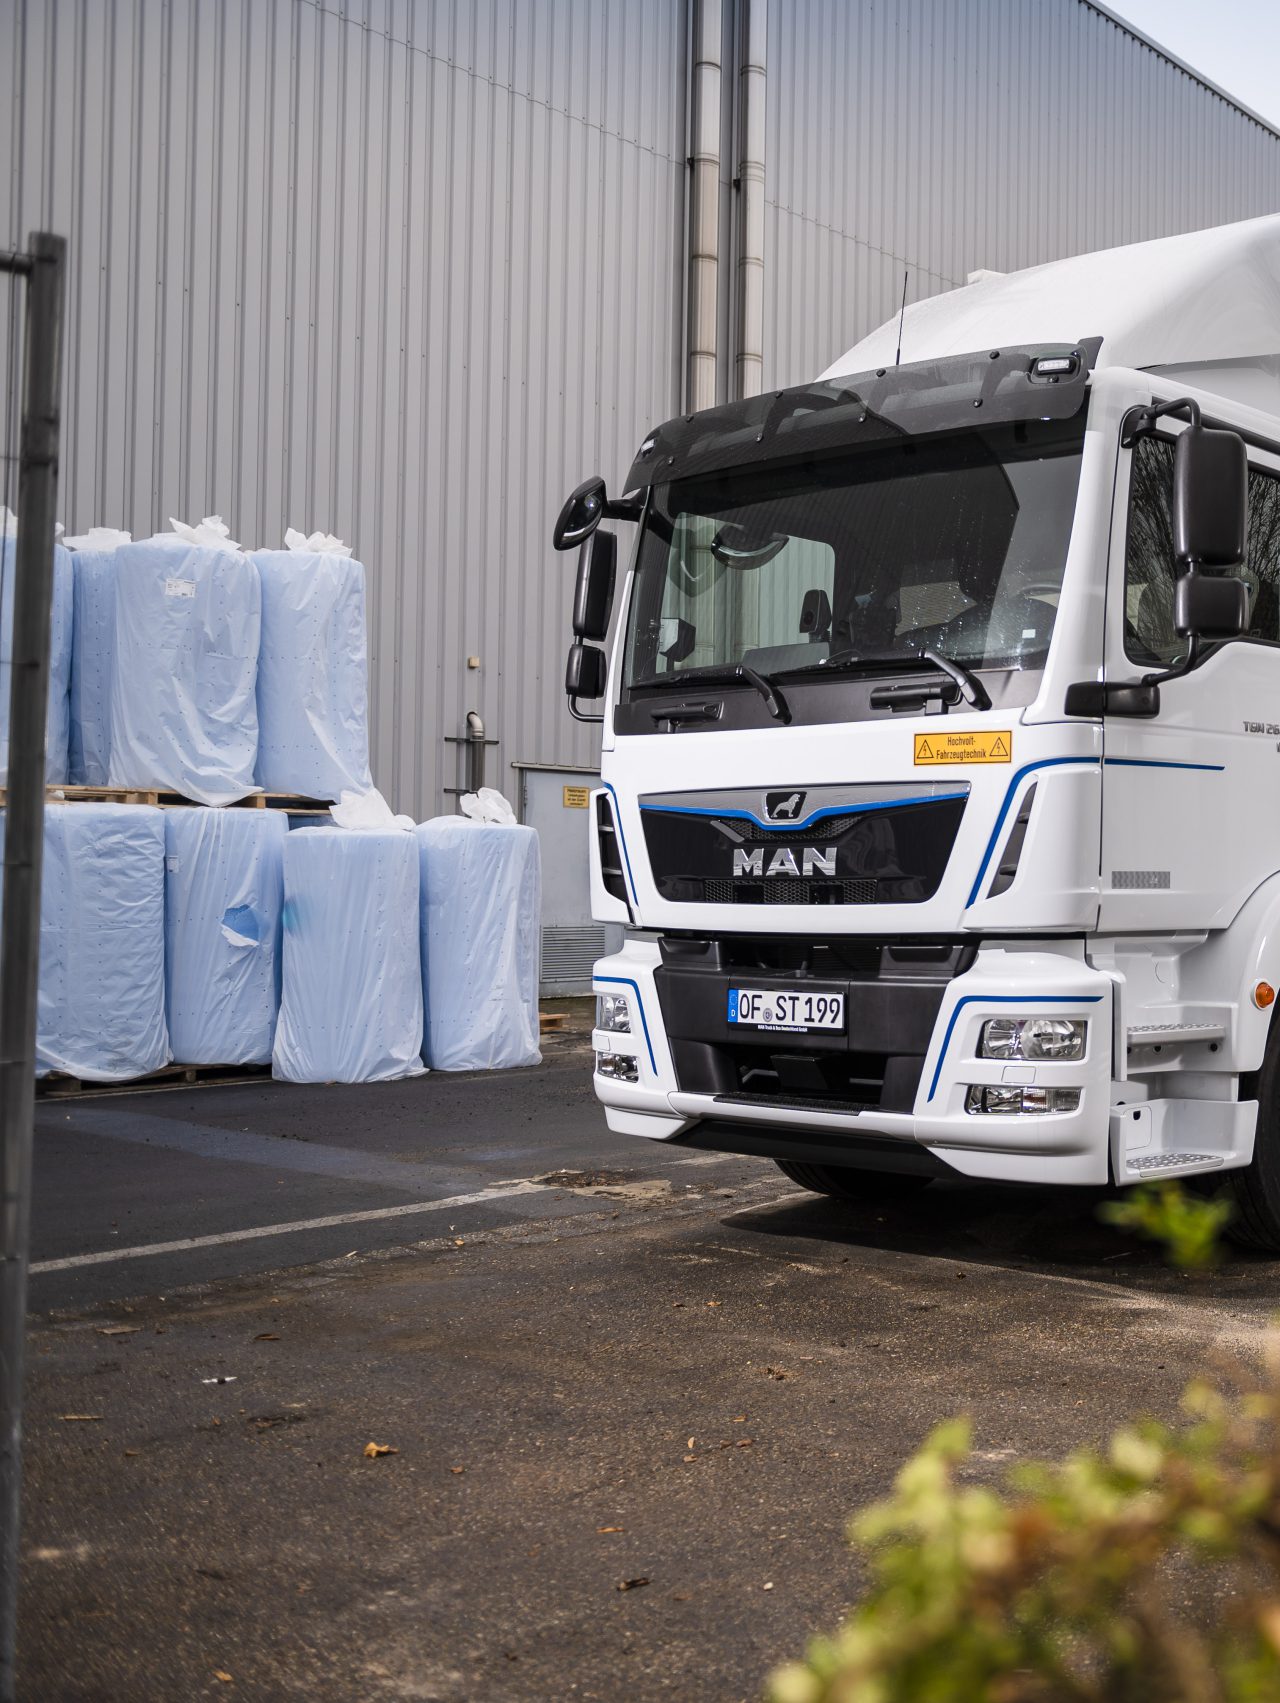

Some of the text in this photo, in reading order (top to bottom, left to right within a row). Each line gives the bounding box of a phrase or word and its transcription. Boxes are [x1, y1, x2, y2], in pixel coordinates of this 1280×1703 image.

[947, 736, 976, 746] Hochvolt-
[936, 749, 987, 761] Fahrzeugtechnik
[732, 846, 838, 876] MAN
[731, 1009, 736, 1017] D
[739, 993, 841, 1024] OF ST 199
